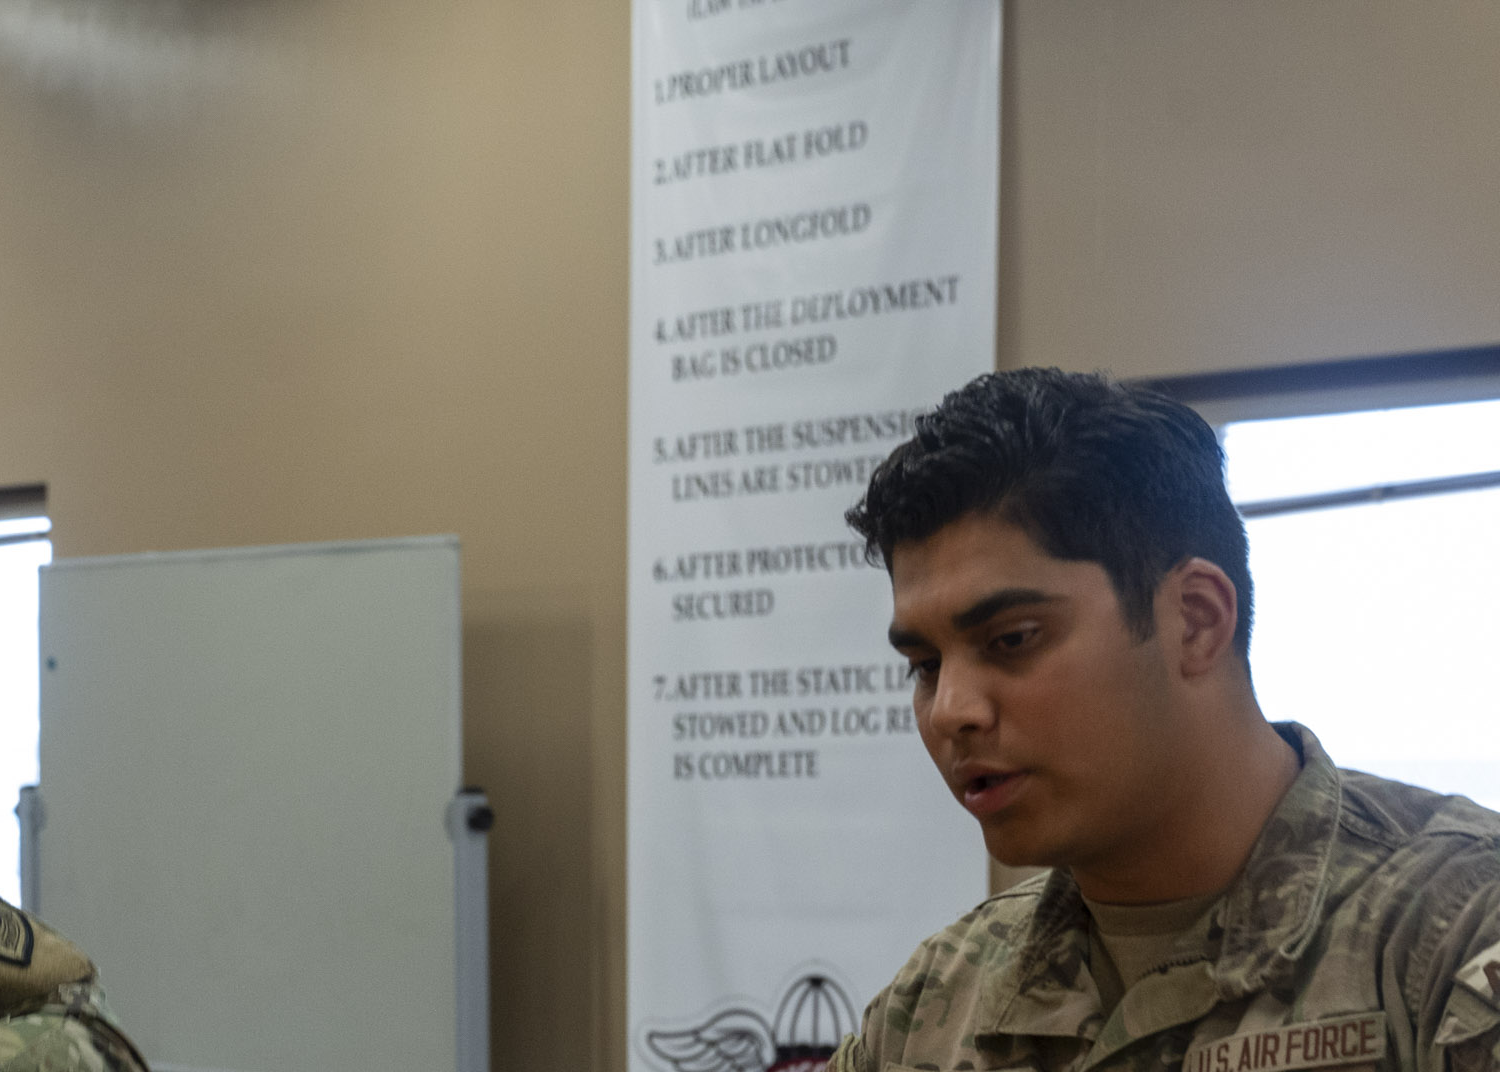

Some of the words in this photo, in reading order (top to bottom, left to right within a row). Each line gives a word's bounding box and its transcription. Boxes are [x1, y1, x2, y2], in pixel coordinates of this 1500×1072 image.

[760, 39, 852, 84] LAYOUT
[744, 133, 797, 168] FLAT
[804, 120, 869, 159] FOLD
[741, 203, 872, 251] LONGFOLD
[742, 299, 783, 332] THE
[791, 275, 960, 325] DEPLOYMENT
[672, 349, 717, 381] BAG
[721, 346, 742, 376] IS
[745, 334, 837, 373] CLOSED
[745, 423, 785, 453] THE
[672, 468, 735, 502] LINES
[738, 464, 782, 494] ARE
[673, 589, 775, 621] SECURED
[750, 669, 790, 697] THE
[797, 665, 879, 694] STATIC
[673, 710, 770, 740] STOWED
[774, 708, 827, 737] AND
[832, 706, 881, 735] LOG
[674, 754, 695, 781] IS
[699, 750, 819, 780] COMPLETE
[1238, 1033, 1279, 1072] AIR
[1285, 1020, 1378, 1064] FORCE
